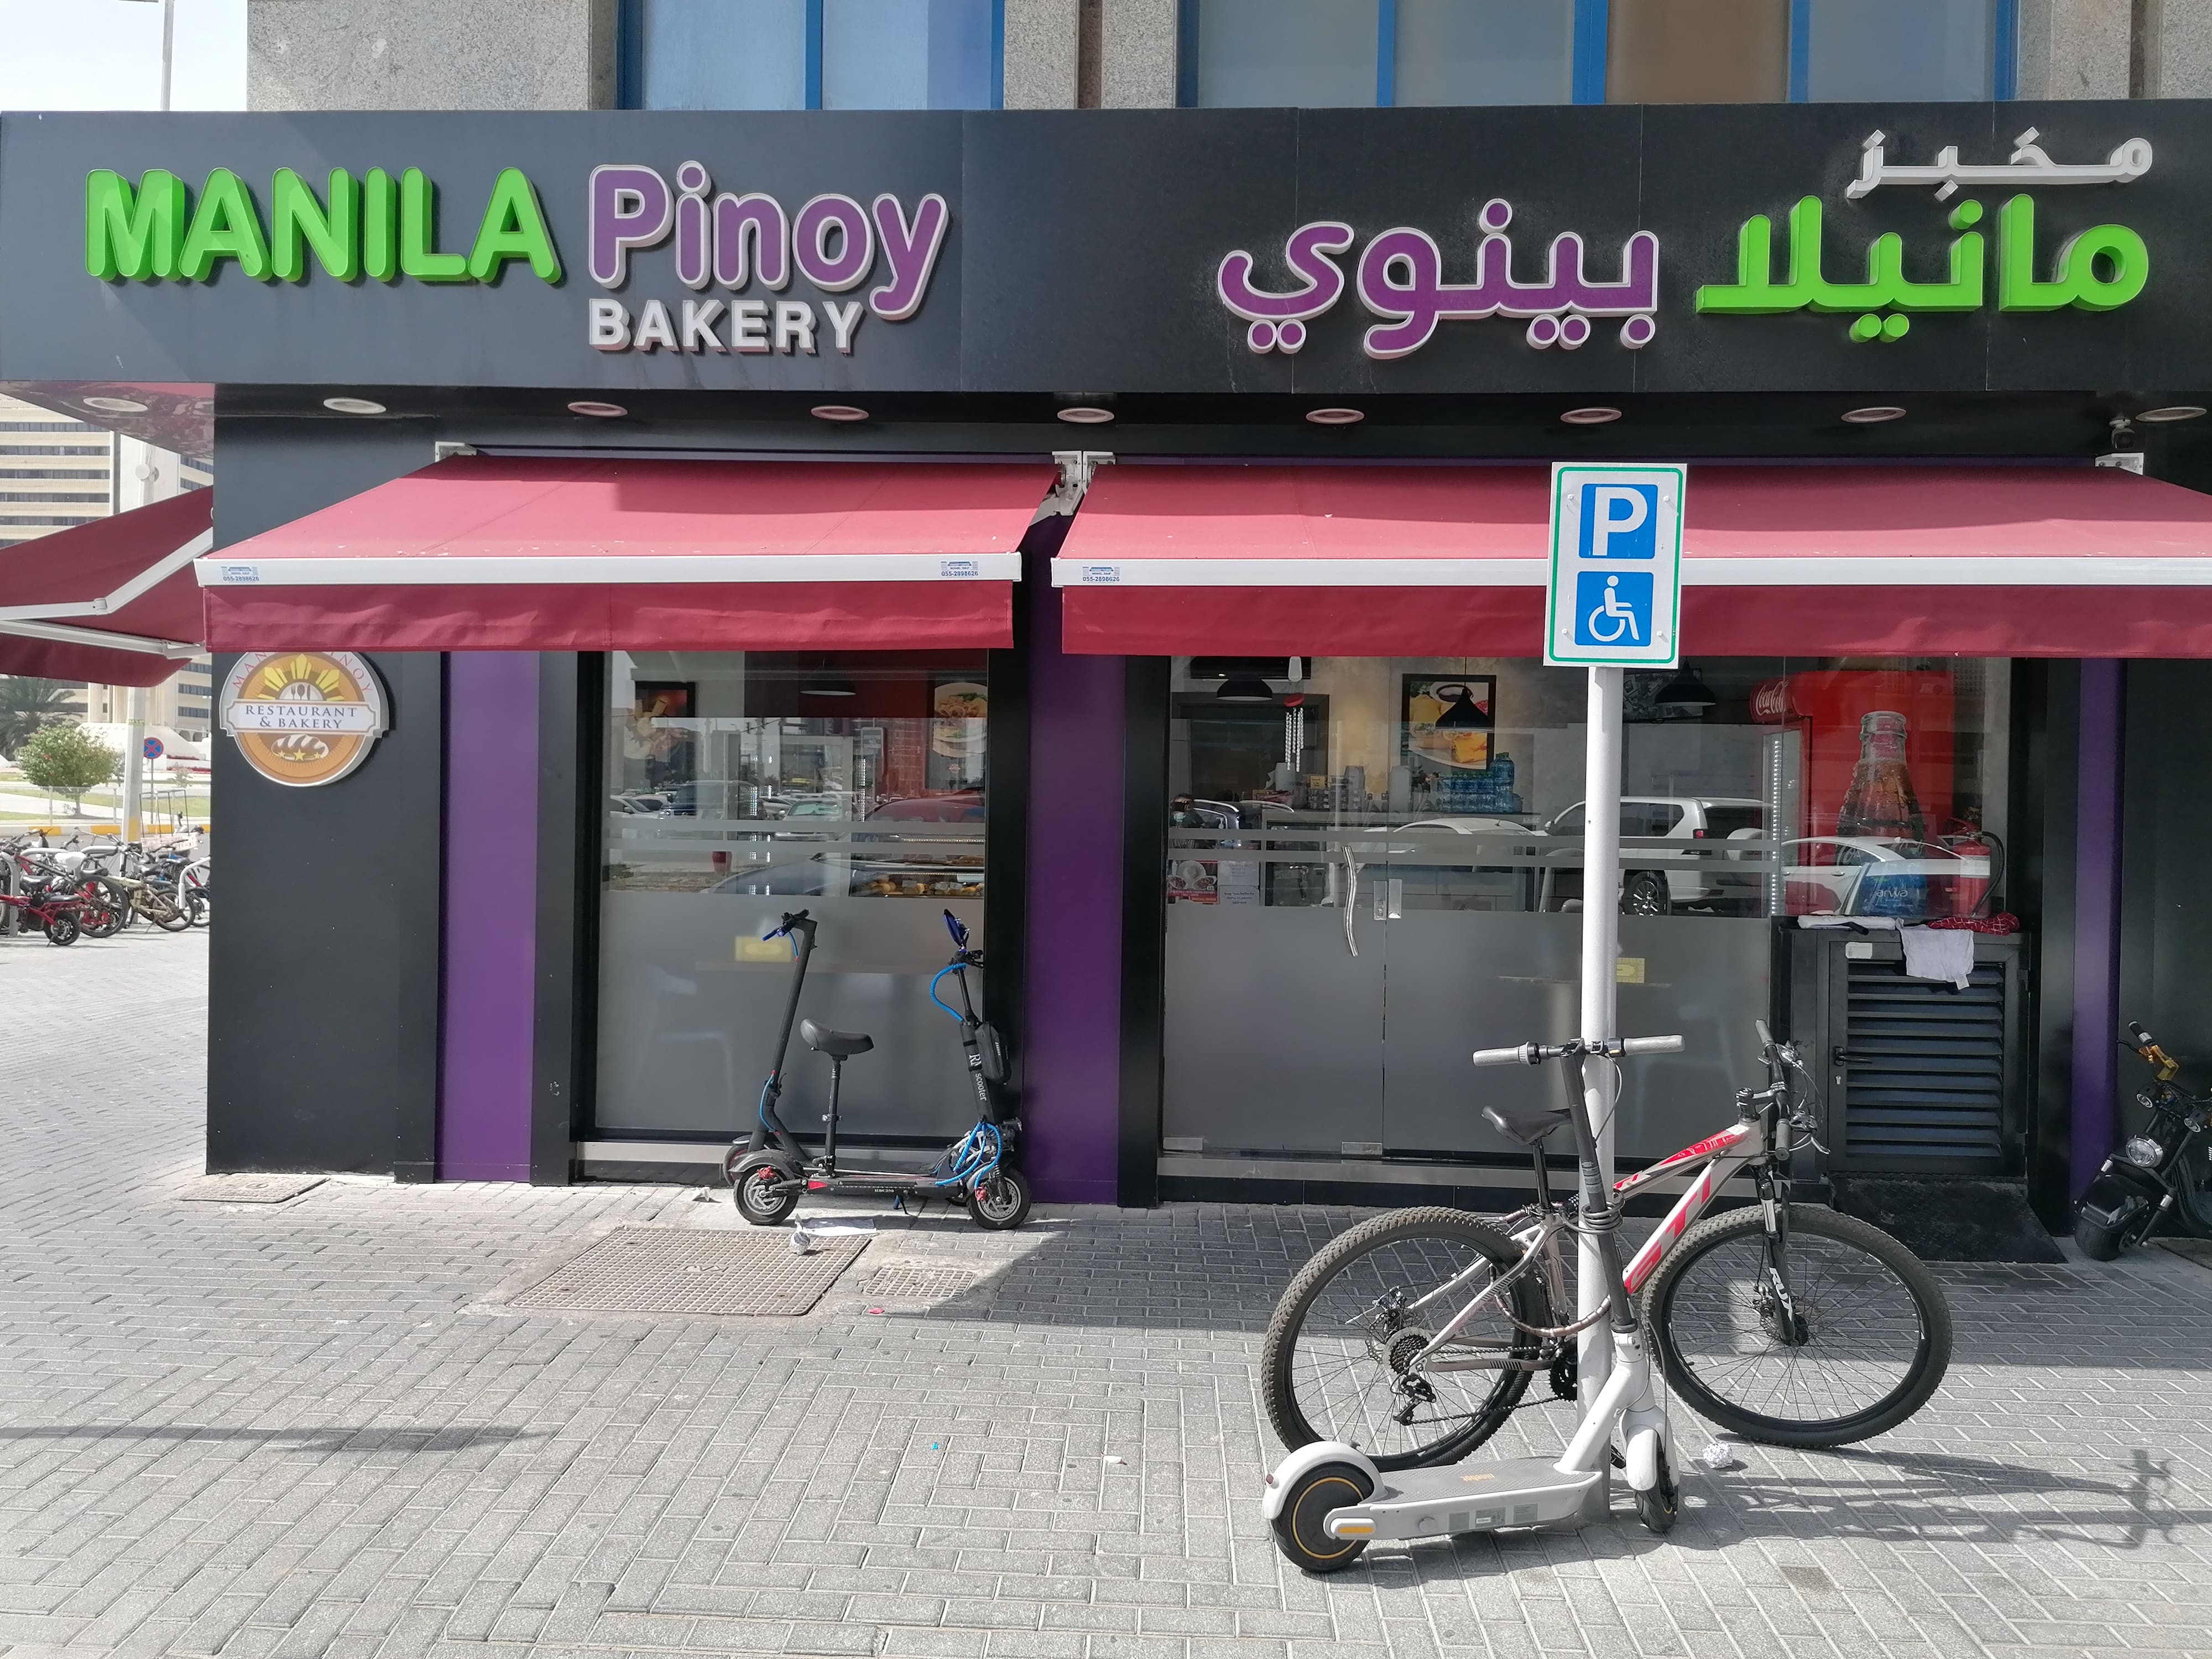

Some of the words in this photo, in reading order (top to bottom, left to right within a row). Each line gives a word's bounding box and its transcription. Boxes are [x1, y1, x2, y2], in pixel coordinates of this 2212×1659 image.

[1845, 127, 2154, 200] مخبز
[86, 165, 562, 284] MANILA
[588, 160, 951, 321] Pinoy
[1695, 195, 2150, 342] مانيلا
[1218, 198, 1659, 359] بينوي
[589, 299, 865, 354] BAKERY
[1592, 487, 1648, 556] P
[232, 651, 267, 689] MAN
[330, 651, 373, 692] NOY
[246, 705, 357, 717] RESTAURANT
[260, 716, 272, 727] &
[279, 718, 342, 729] BAKERY
[975, 1073, 987, 1101] scooter
